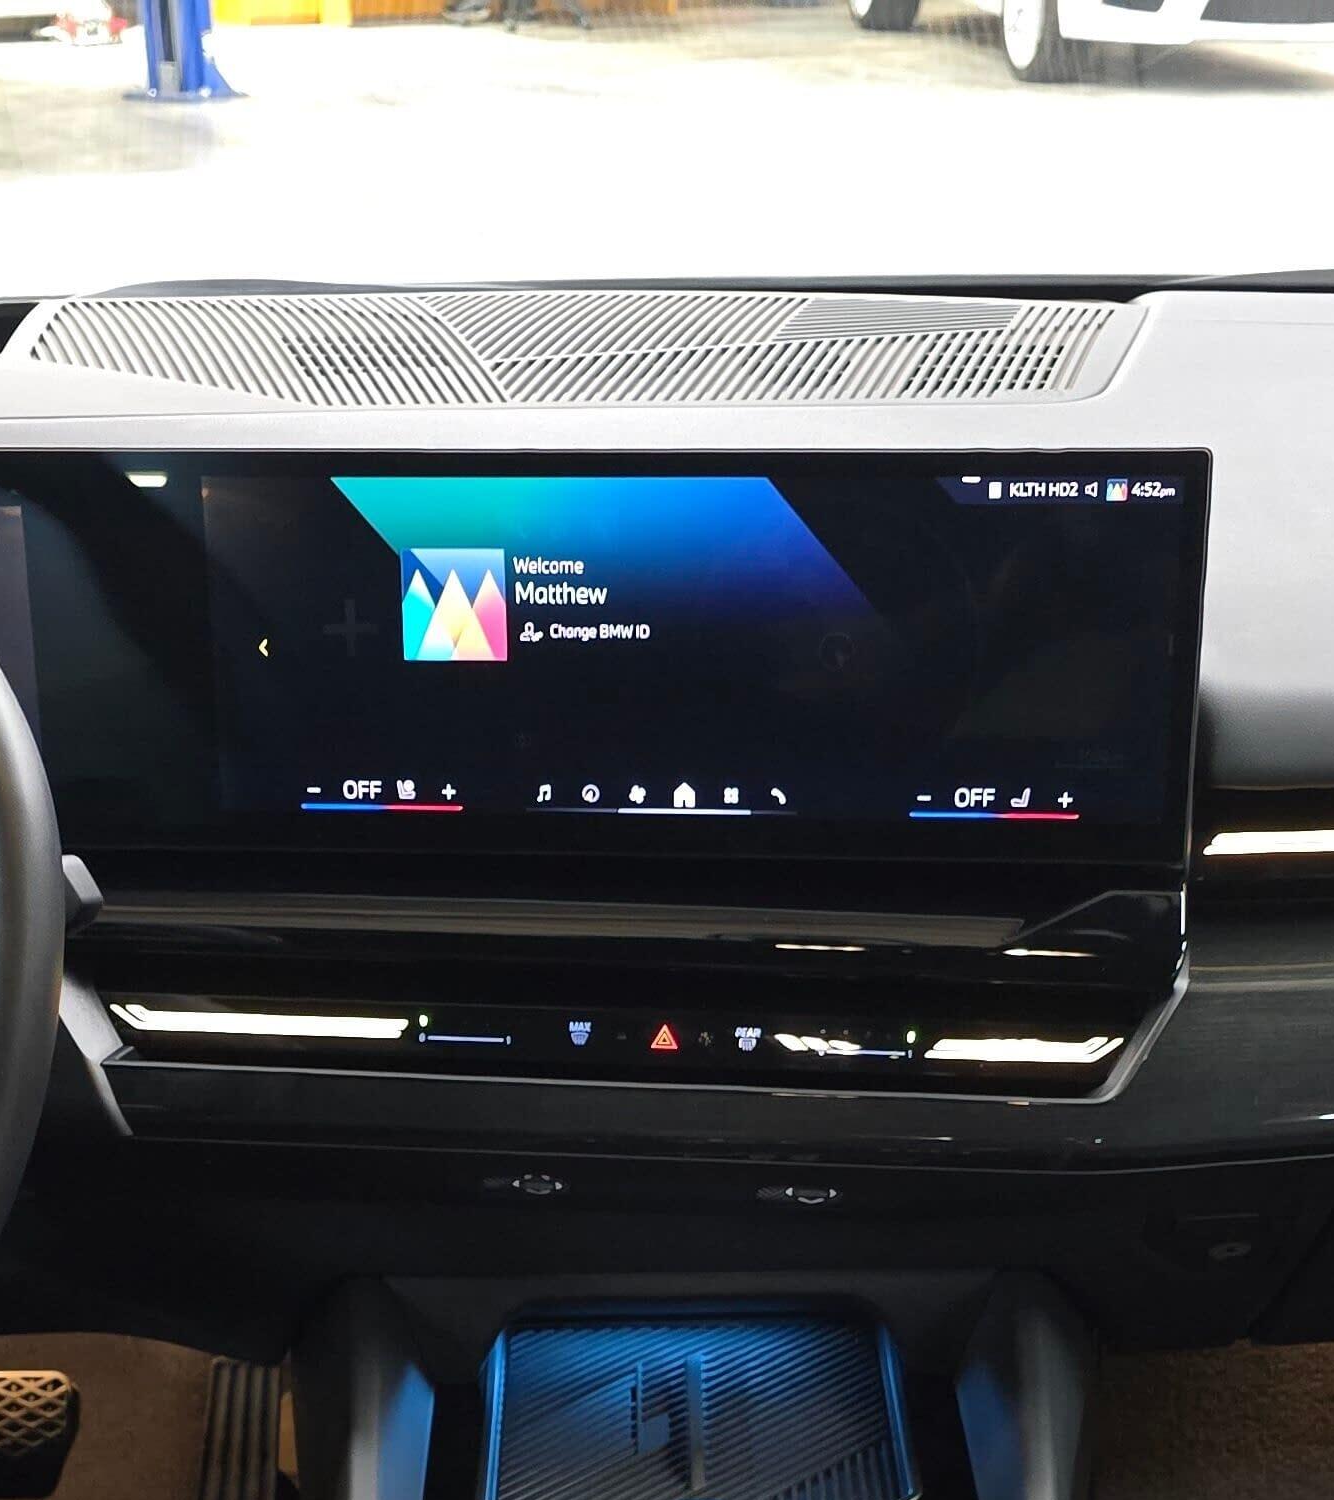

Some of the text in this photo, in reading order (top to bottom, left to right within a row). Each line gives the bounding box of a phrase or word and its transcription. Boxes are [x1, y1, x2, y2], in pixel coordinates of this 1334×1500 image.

[1009, 481, 1079, 498] KLTH HD2
[1131, 481, 1176, 498] 4:52pm
[513, 556, 584, 575] Welcome
[515, 581, 608, 605] Matthew
[549, 623, 651, 642] Change BMW ID
[342, 779, 383, 800] OFF
[953, 786, 996, 808] OFF
[568, 1021, 592, 1032] MAX
